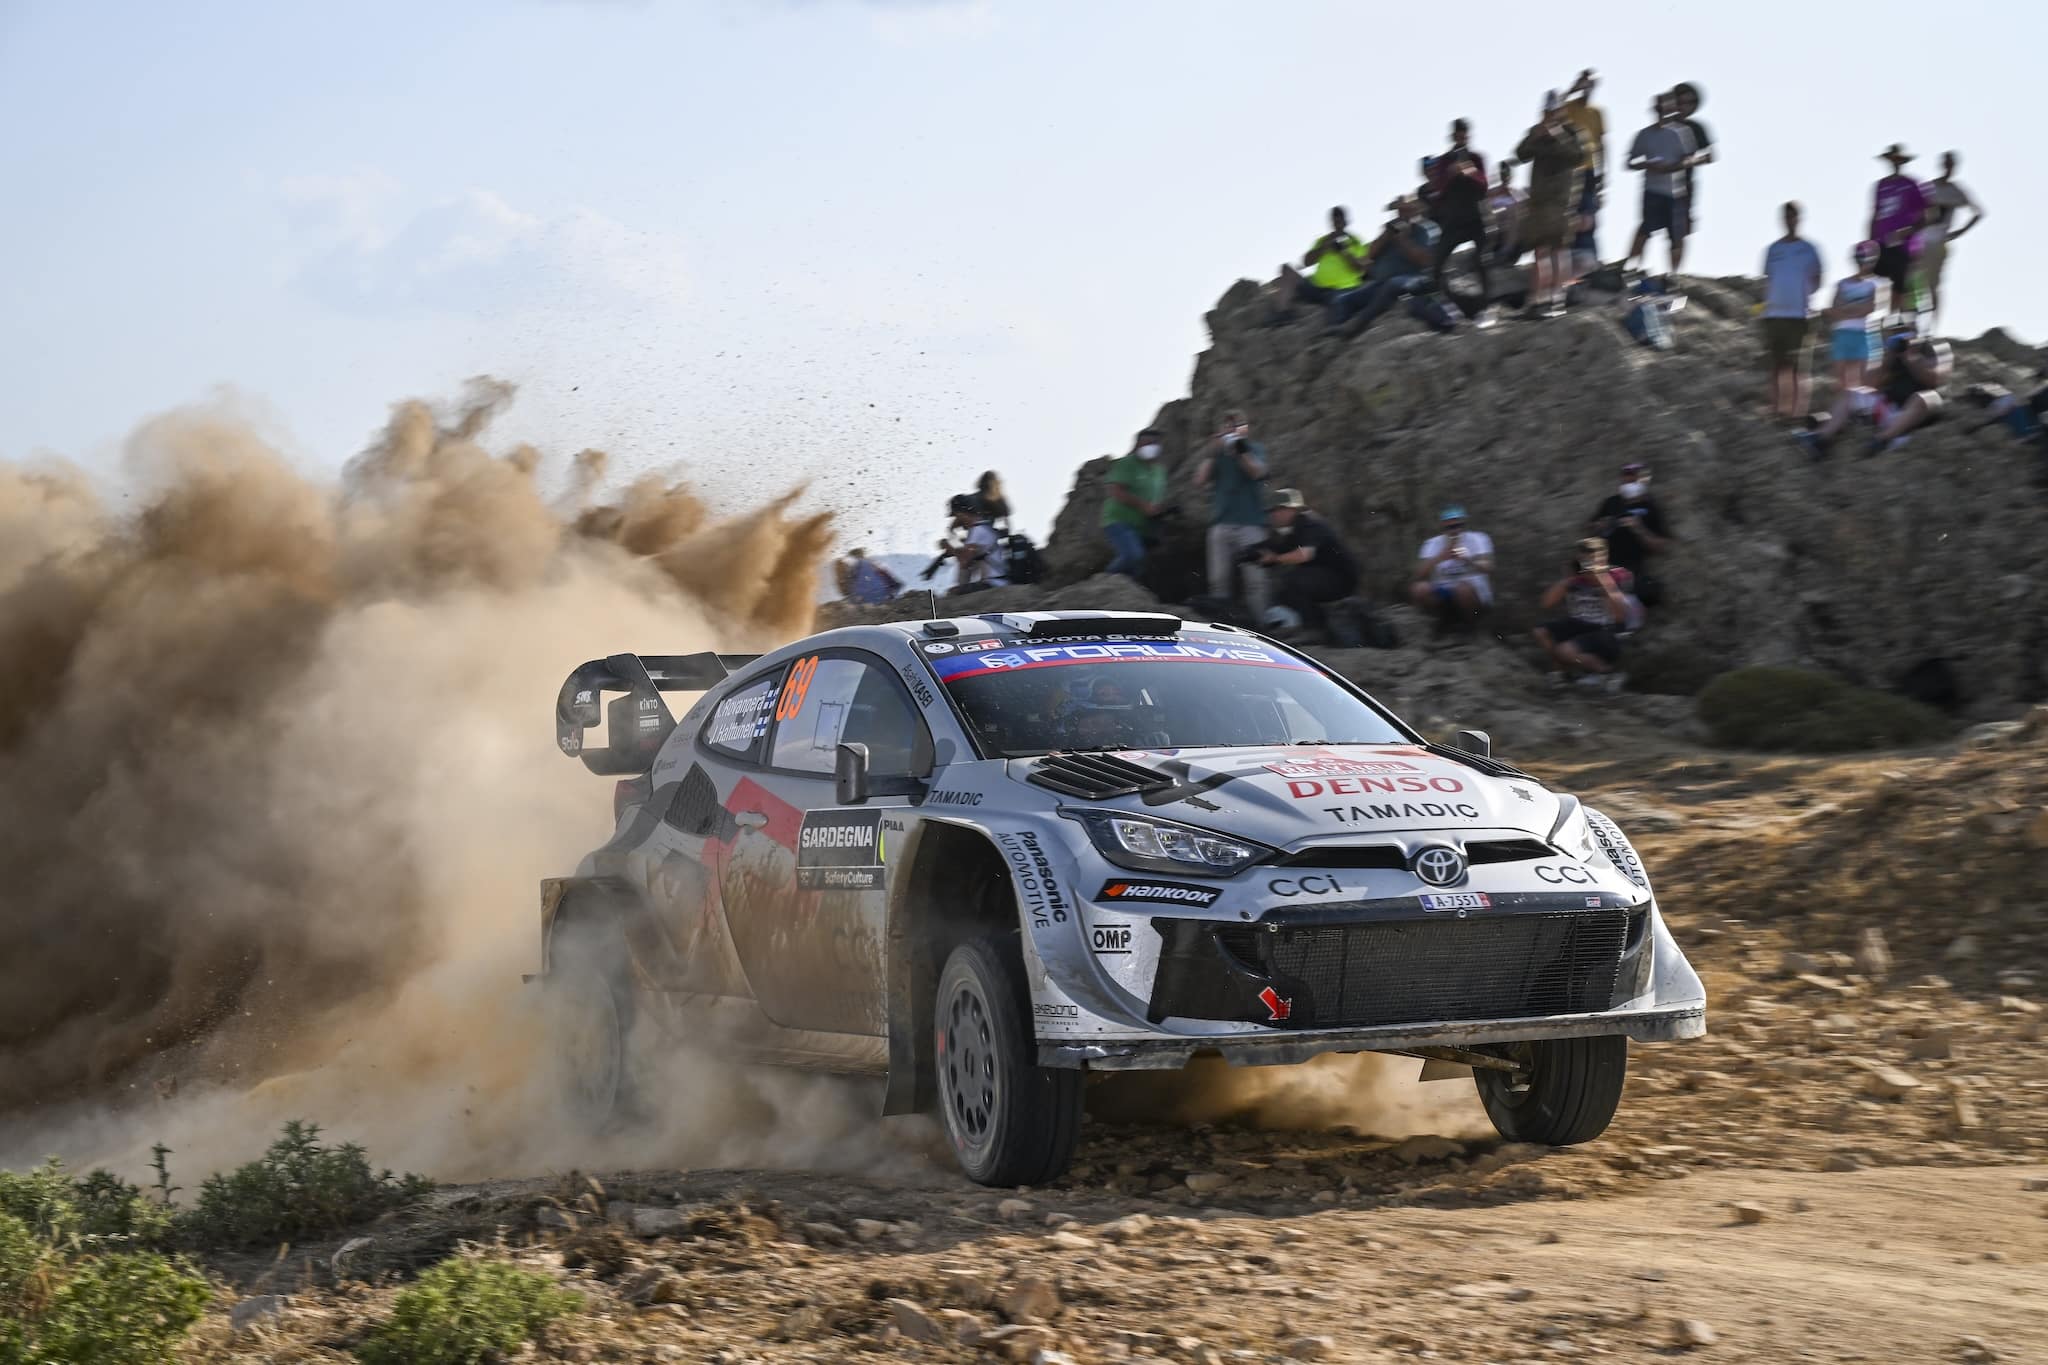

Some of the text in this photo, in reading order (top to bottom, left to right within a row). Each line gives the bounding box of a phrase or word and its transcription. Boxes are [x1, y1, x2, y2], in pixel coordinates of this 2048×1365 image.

[1008, 634, 1101, 646] TOYOTA
[1024, 644, 1275, 663] FORUM8
[776, 655, 819, 721] 69
[928, 790, 984, 806] TAMADIC
[1286, 776, 1465, 800] DENSO
[1323, 802, 1480, 824] TAMADIC
[883, 820, 905, 832] PIAA
[801, 825, 873, 849] SARDEGNA
[825, 871, 874, 887] SafetyCulture
[996, 832, 1050, 929] AUTOMOTIVE
[1016, 831, 1068, 923] Panasonic
[1435, 895, 1479, 907] A-7551
[1093, 929, 1132, 949] OMP
